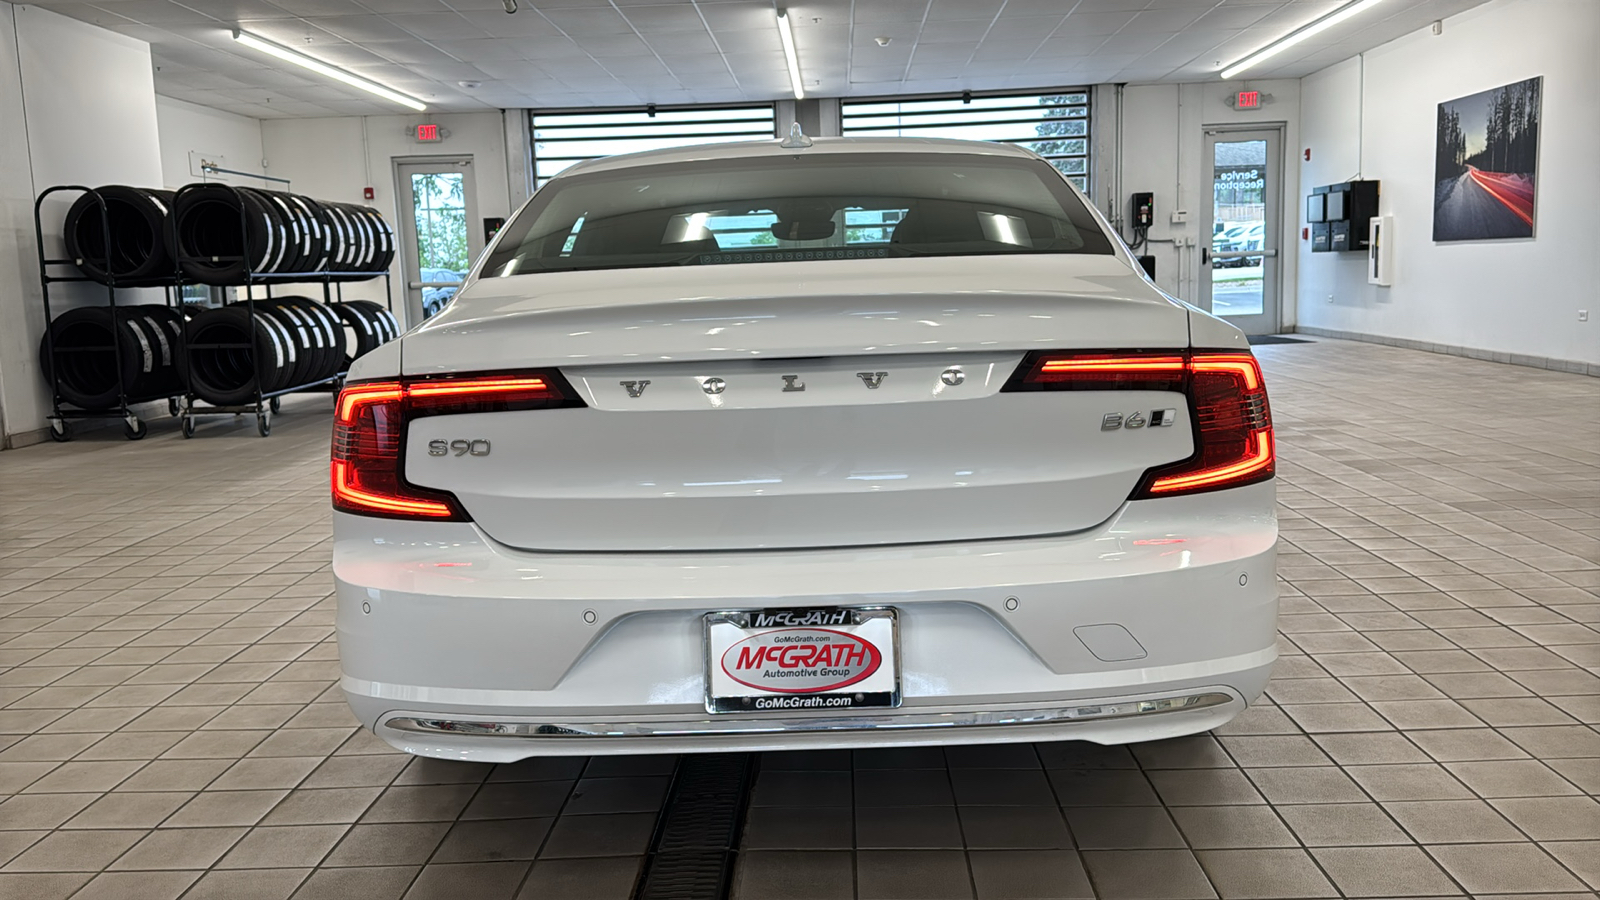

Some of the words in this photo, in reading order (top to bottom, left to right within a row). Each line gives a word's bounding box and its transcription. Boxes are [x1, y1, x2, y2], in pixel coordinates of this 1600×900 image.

[1239, 91, 1258, 107] EXIT
[418, 124, 437, 140] EXIT
[619, 368, 966, 398] VOLVO
[1100, 411, 1147, 431] B6
[428, 439, 491, 457] S90
[774, 635, 831, 644] GoMcGrath.com
[763, 669, 818, 678] Automotive
[820, 668, 850, 678] Group
[755, 696, 852, 709] GoMcGrath.com
